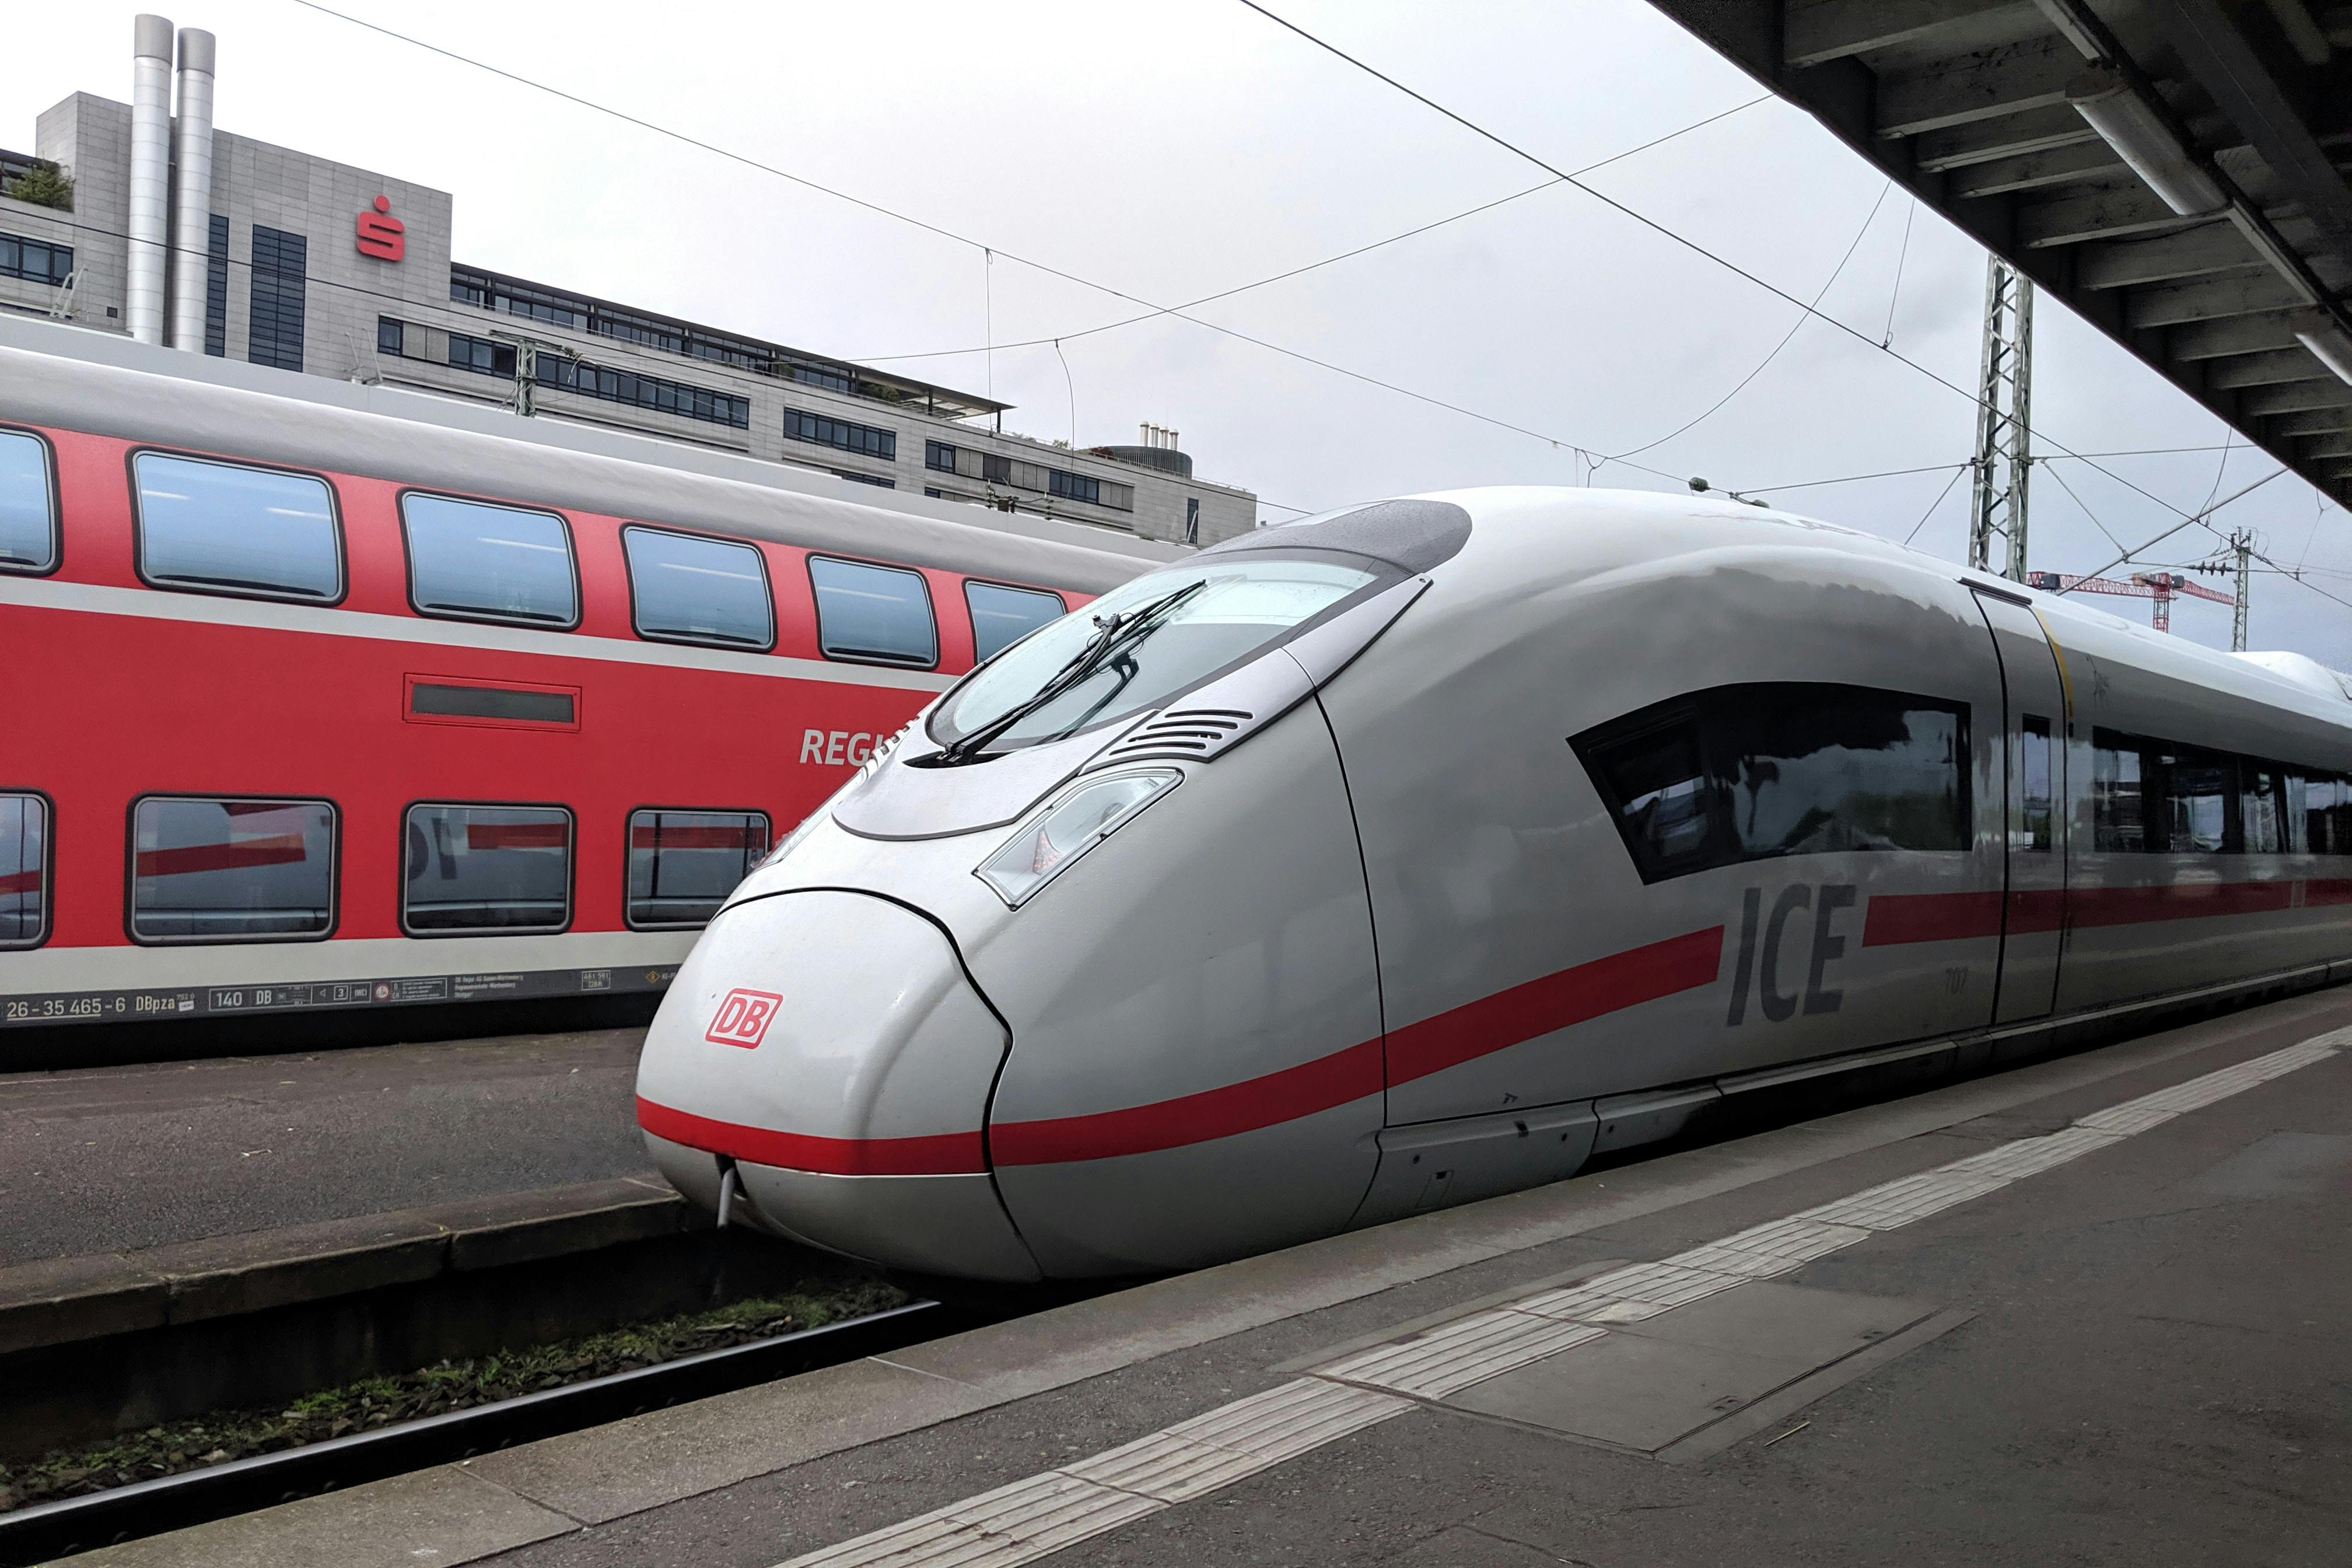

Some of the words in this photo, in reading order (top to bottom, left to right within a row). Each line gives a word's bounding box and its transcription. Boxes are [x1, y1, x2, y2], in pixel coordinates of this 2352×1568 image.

[1727, 883, 1857, 1027] ICE
[216, 991, 243, 1007] 140
[255, 990, 272, 1005] DB
[338, 988, 344, 998] 3
[135, 995, 175, 1014] DBpza
[715, 996, 771, 1038] DB
